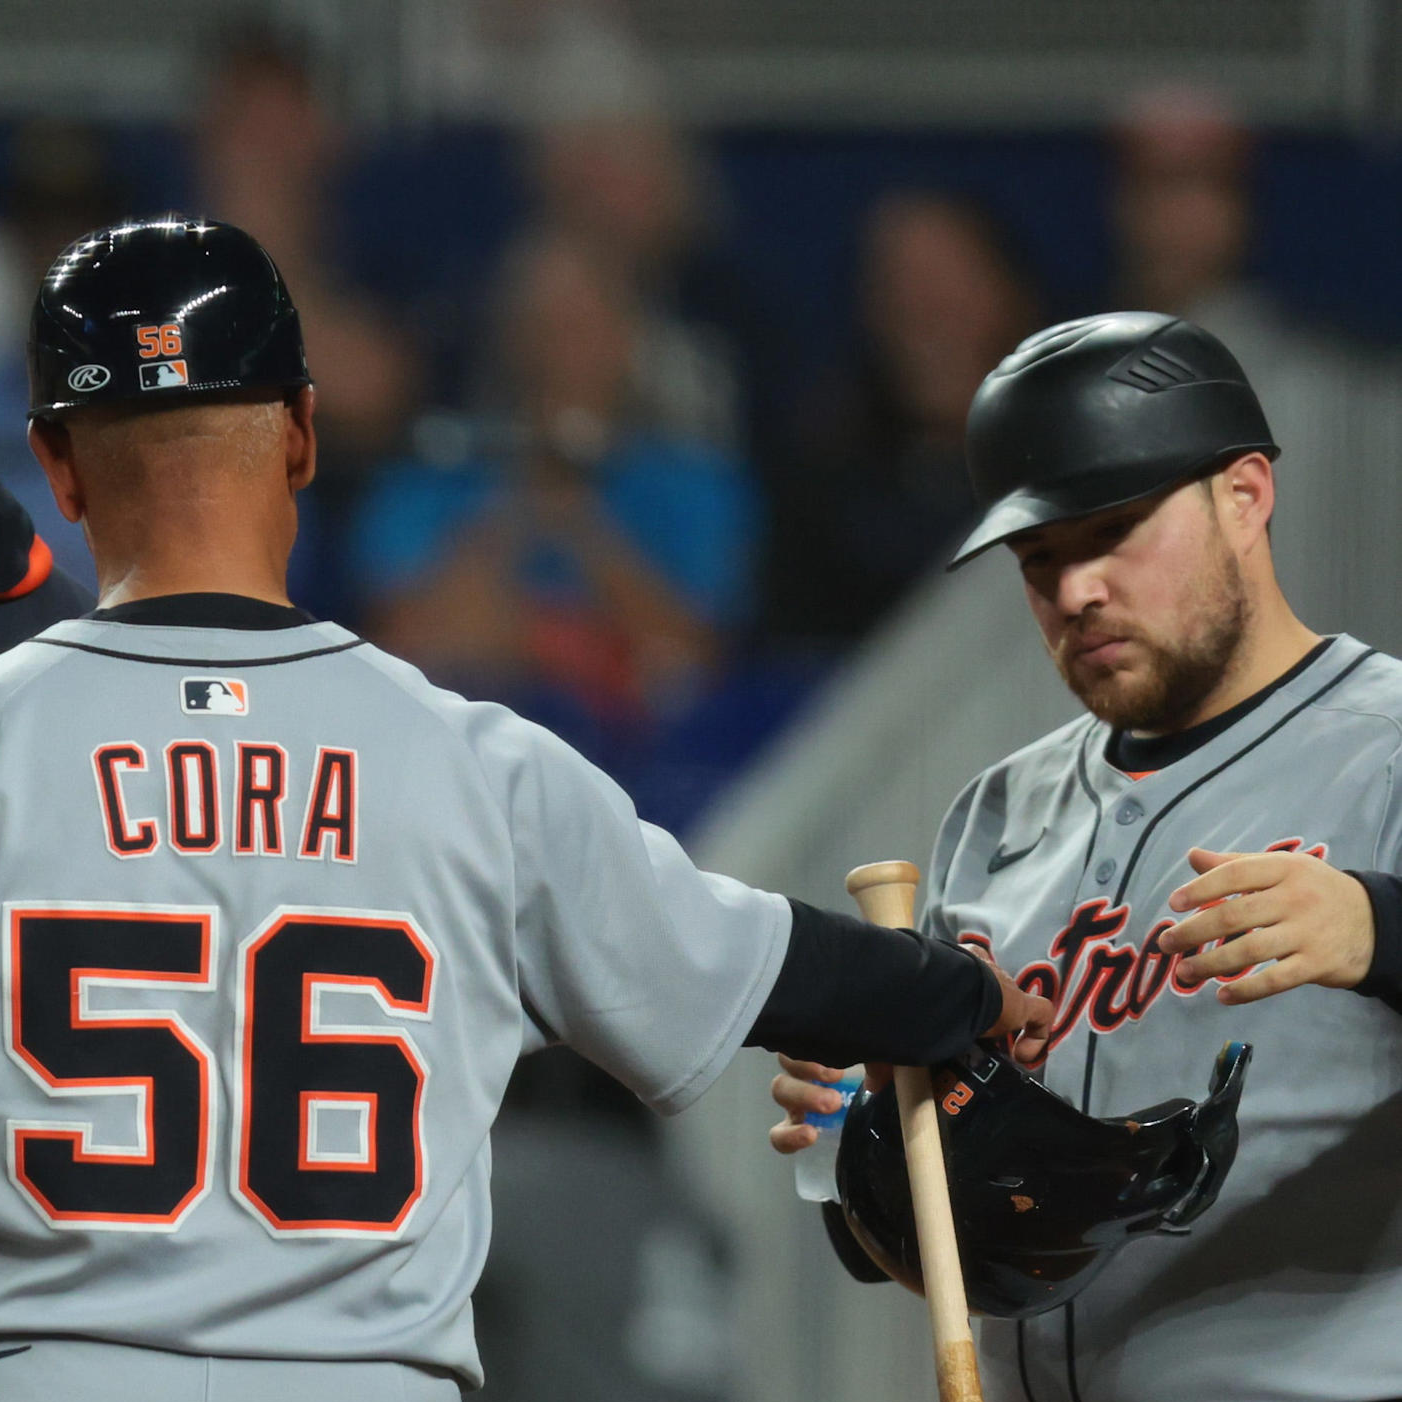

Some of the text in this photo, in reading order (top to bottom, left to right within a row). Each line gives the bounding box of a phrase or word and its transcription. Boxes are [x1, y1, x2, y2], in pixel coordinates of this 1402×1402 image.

[137, 324, 182, 358] 56
[91, 739, 358, 864] CORA
[2, 901, 440, 1240] 56
